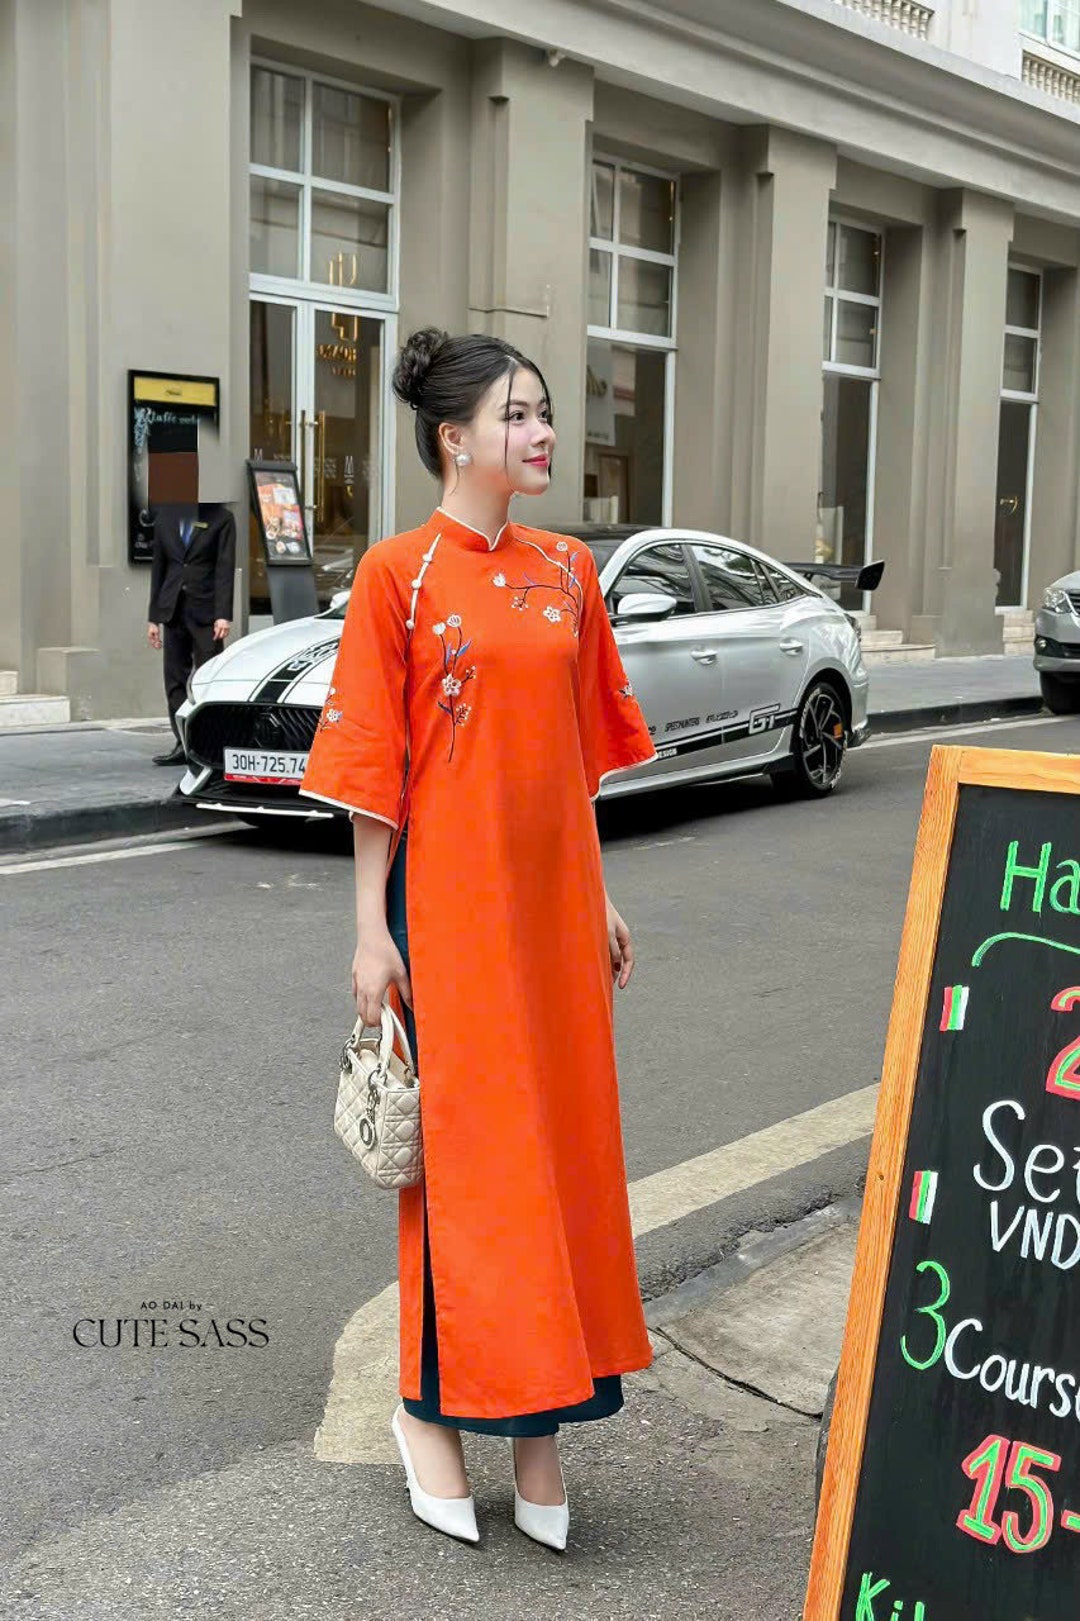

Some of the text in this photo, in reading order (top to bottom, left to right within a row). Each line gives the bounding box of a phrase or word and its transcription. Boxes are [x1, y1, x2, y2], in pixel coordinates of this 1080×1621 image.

[749, 703, 780, 734] GT
[1000, 840, 1080, 916] Ha
[990, 1200, 1080, 1270] VND
[900, 1261, 1080, 1424] 3 Cours
